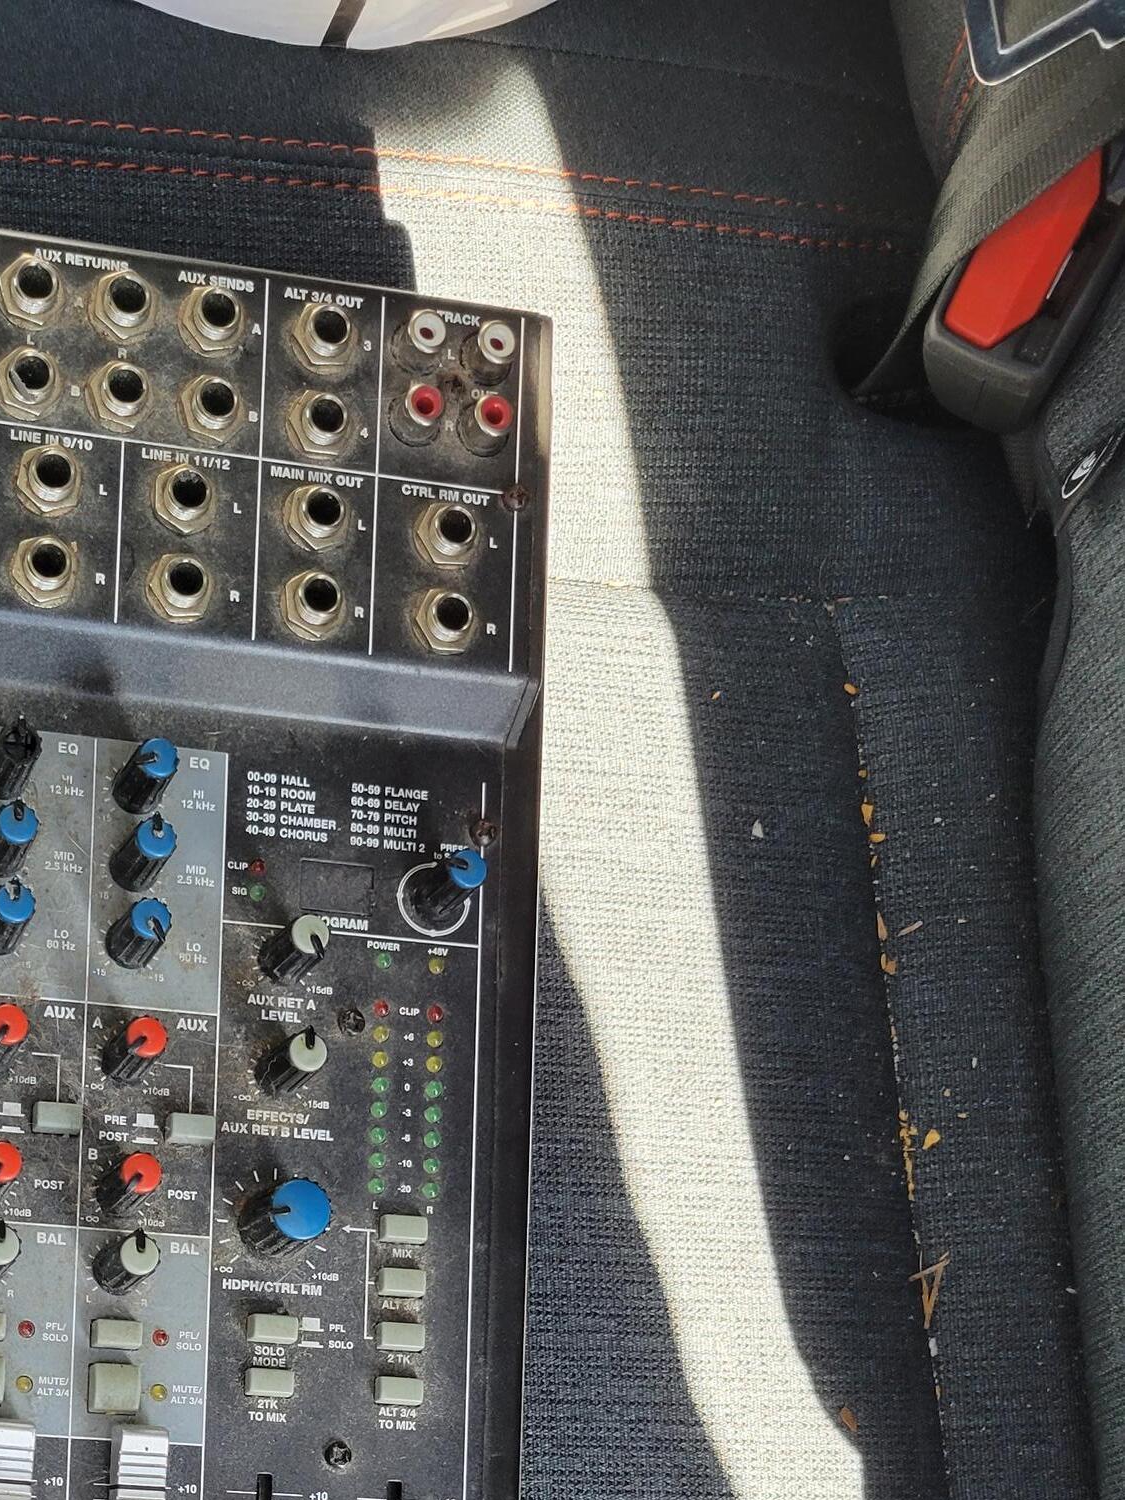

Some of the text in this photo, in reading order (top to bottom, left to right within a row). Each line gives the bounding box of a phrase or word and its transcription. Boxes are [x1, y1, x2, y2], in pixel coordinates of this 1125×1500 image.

[34, 248, 129, 271] AUX RETURNS
[178, 271, 255, 293] AUX SENDS
[284, 287, 363, 309] ALT 3/4 OUT
[11, 430, 92, 450] LINE IN 9/10
[142, 448, 230, 470] LINE IN 11/12
[271, 466, 363, 488] MAIN MIX OUT
[402, 484, 490, 506] CTRL RM OUT
[190, 757, 209, 770] EQ
[248, 771, 310, 787] 00-09 HALL
[248, 785, 315, 801] 10-19 ROOM
[352, 783, 428, 800] 50-59 FLANGE
[247, 798, 315, 814] 20-29 PLATE
[351, 796, 420, 812] 60-69 DELAY
[246, 811, 336, 830] 30-39 CHAMBER
[351, 810, 417, 825] 70-79 PITCH
[246, 825, 327, 842] 40-49 CHORUS
[351, 823, 416, 838] 80-89 MULTI
[350, 836, 425, 852] 90-99 MULTI 2
[228, 861, 248, 870] CLIP
[367, 941, 400, 951] POWER
[248, 994, 315, 1010] AUX RET A
[262, 1010, 301, 1023] LEVEL
[399, 1007, 419, 1016] CLIP
[177, 1018, 207, 1032] AUX
[247, 1109, 310, 1124] EFFECTS/
[221, 1122, 333, 1141] AUX RET B LEVEL
[168, 1190, 197, 1200] POST
[171, 1242, 199, 1255] BAL
[393, 1248, 411, 1259] MIX
[222, 1278, 322, 1296] HDPH/CTRL RM
[330, 1324, 346, 1332] PFL
[43, 1333, 68, 1342] SOLO
[329, 1340, 353, 1349] SOLO
[255, 1346, 284, 1356] SOLO
[253, 1357, 286, 1367] MODE
[39, 1376, 68, 1385] MUTE/
[258, 1400, 278, 1410] 2TK
[379, 1407, 417, 1418] ALT 3/4
[248, 1412, 286, 1422] TO MIX
[379, 1420, 416, 1430] TO MIX
